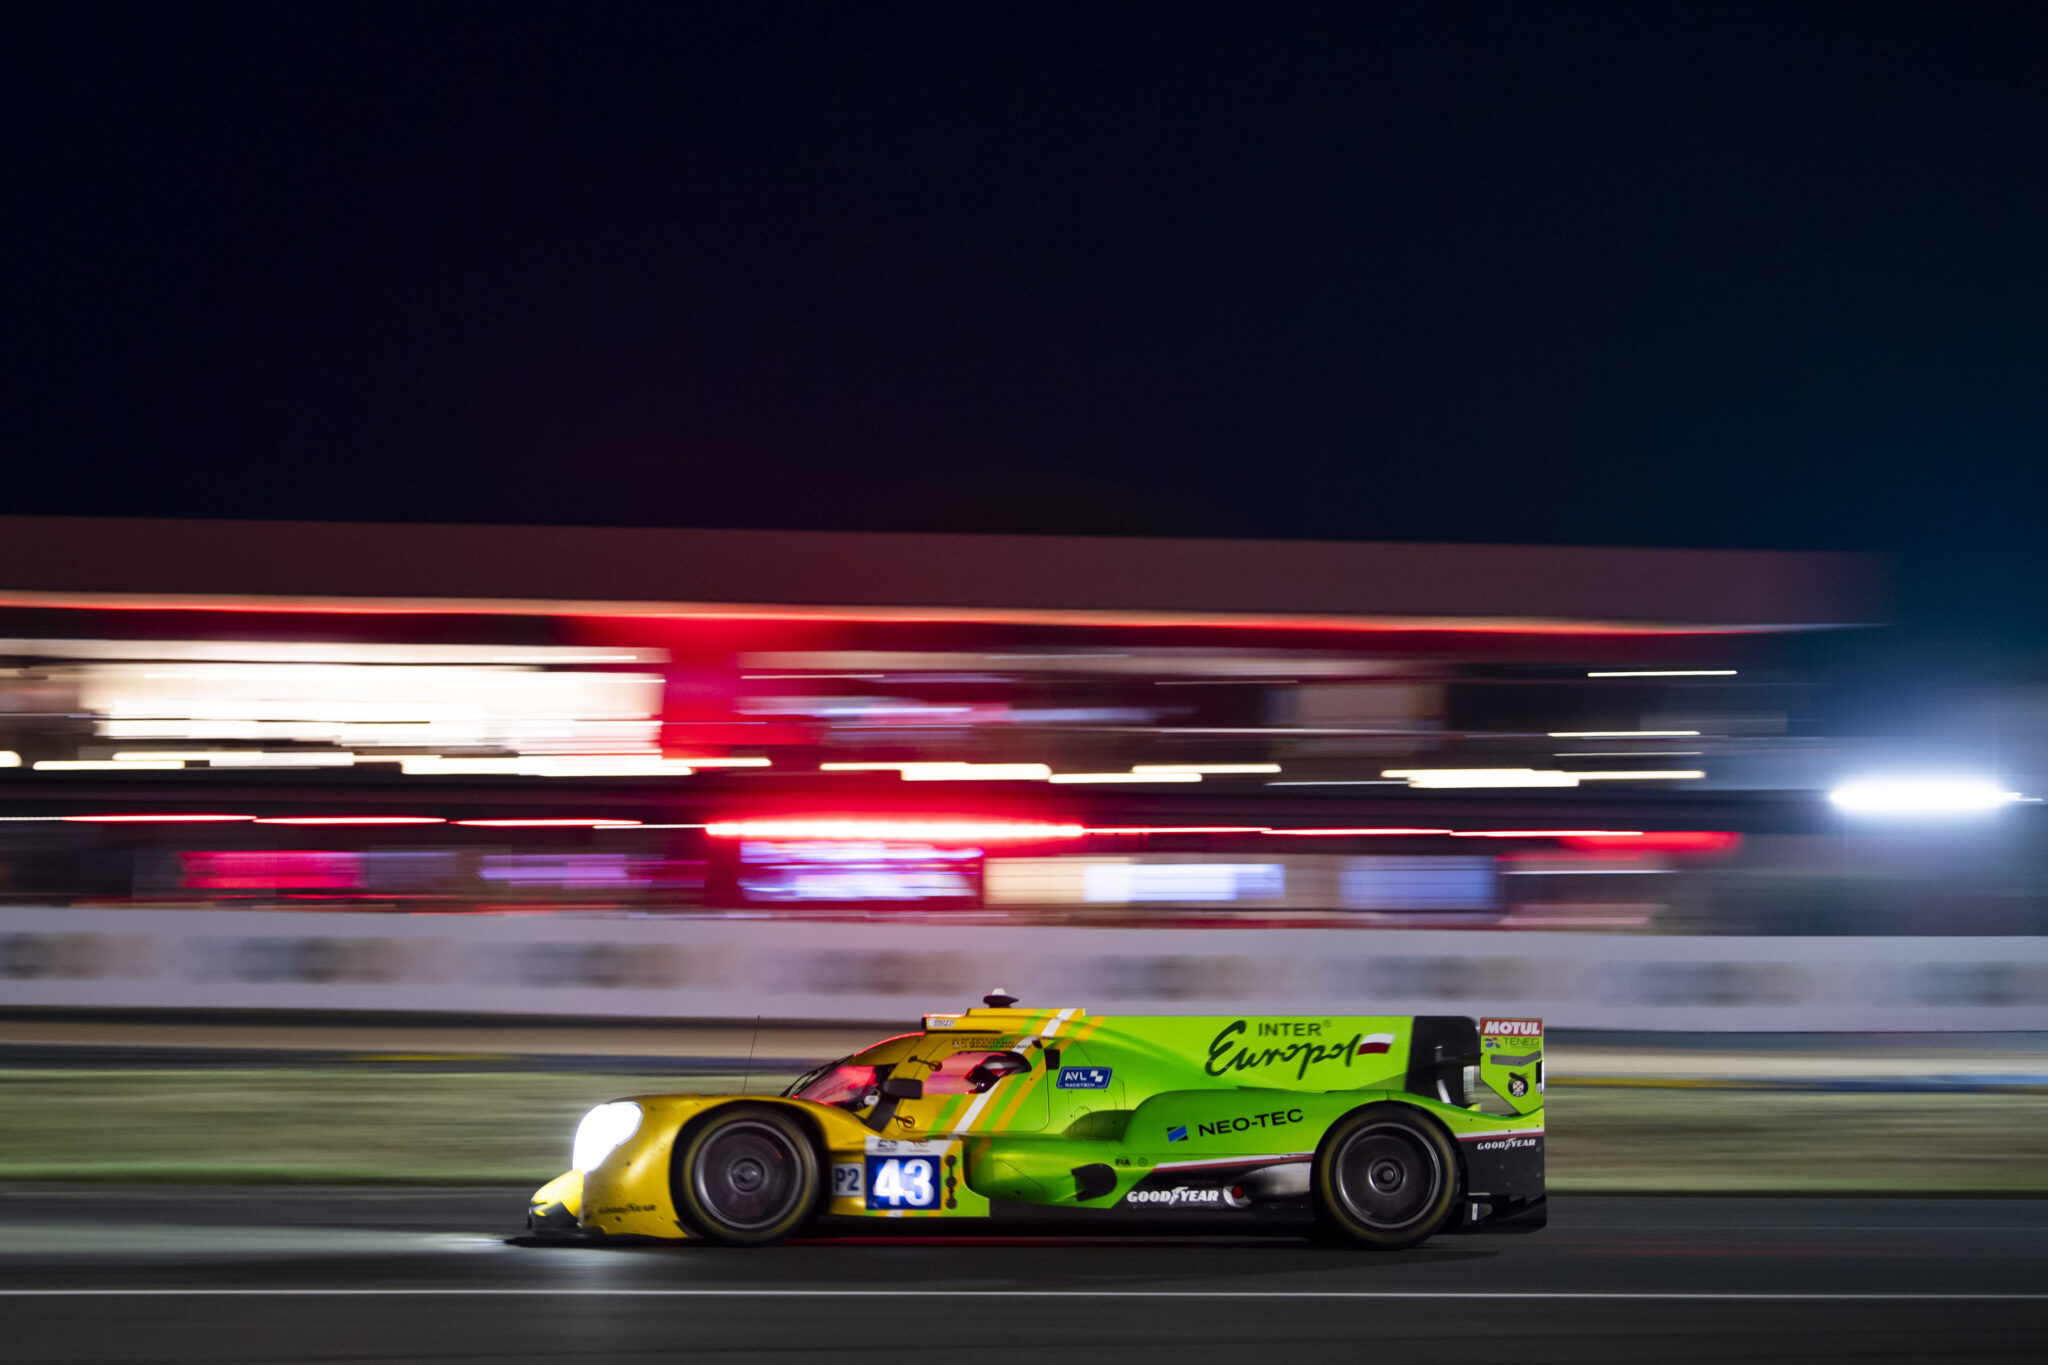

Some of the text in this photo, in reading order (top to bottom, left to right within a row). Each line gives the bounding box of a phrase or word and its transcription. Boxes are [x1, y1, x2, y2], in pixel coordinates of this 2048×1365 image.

[1258, 1022, 1321, 1037] INTER
[1484, 1021, 1540, 1035] MOTUL
[1205, 1019, 1361, 1080] Europol
[1502, 1037, 1540, 1046] TENEG
[1065, 1071, 1087, 1081] AVL
[1198, 1108, 1304, 1138] NEO-TEC
[1477, 1138, 1536, 1150] GOODYEAR
[834, 1168, 859, 1191] P2
[873, 1158, 935, 1207] 43
[1127, 1186, 1219, 1206] GOODYEAR
